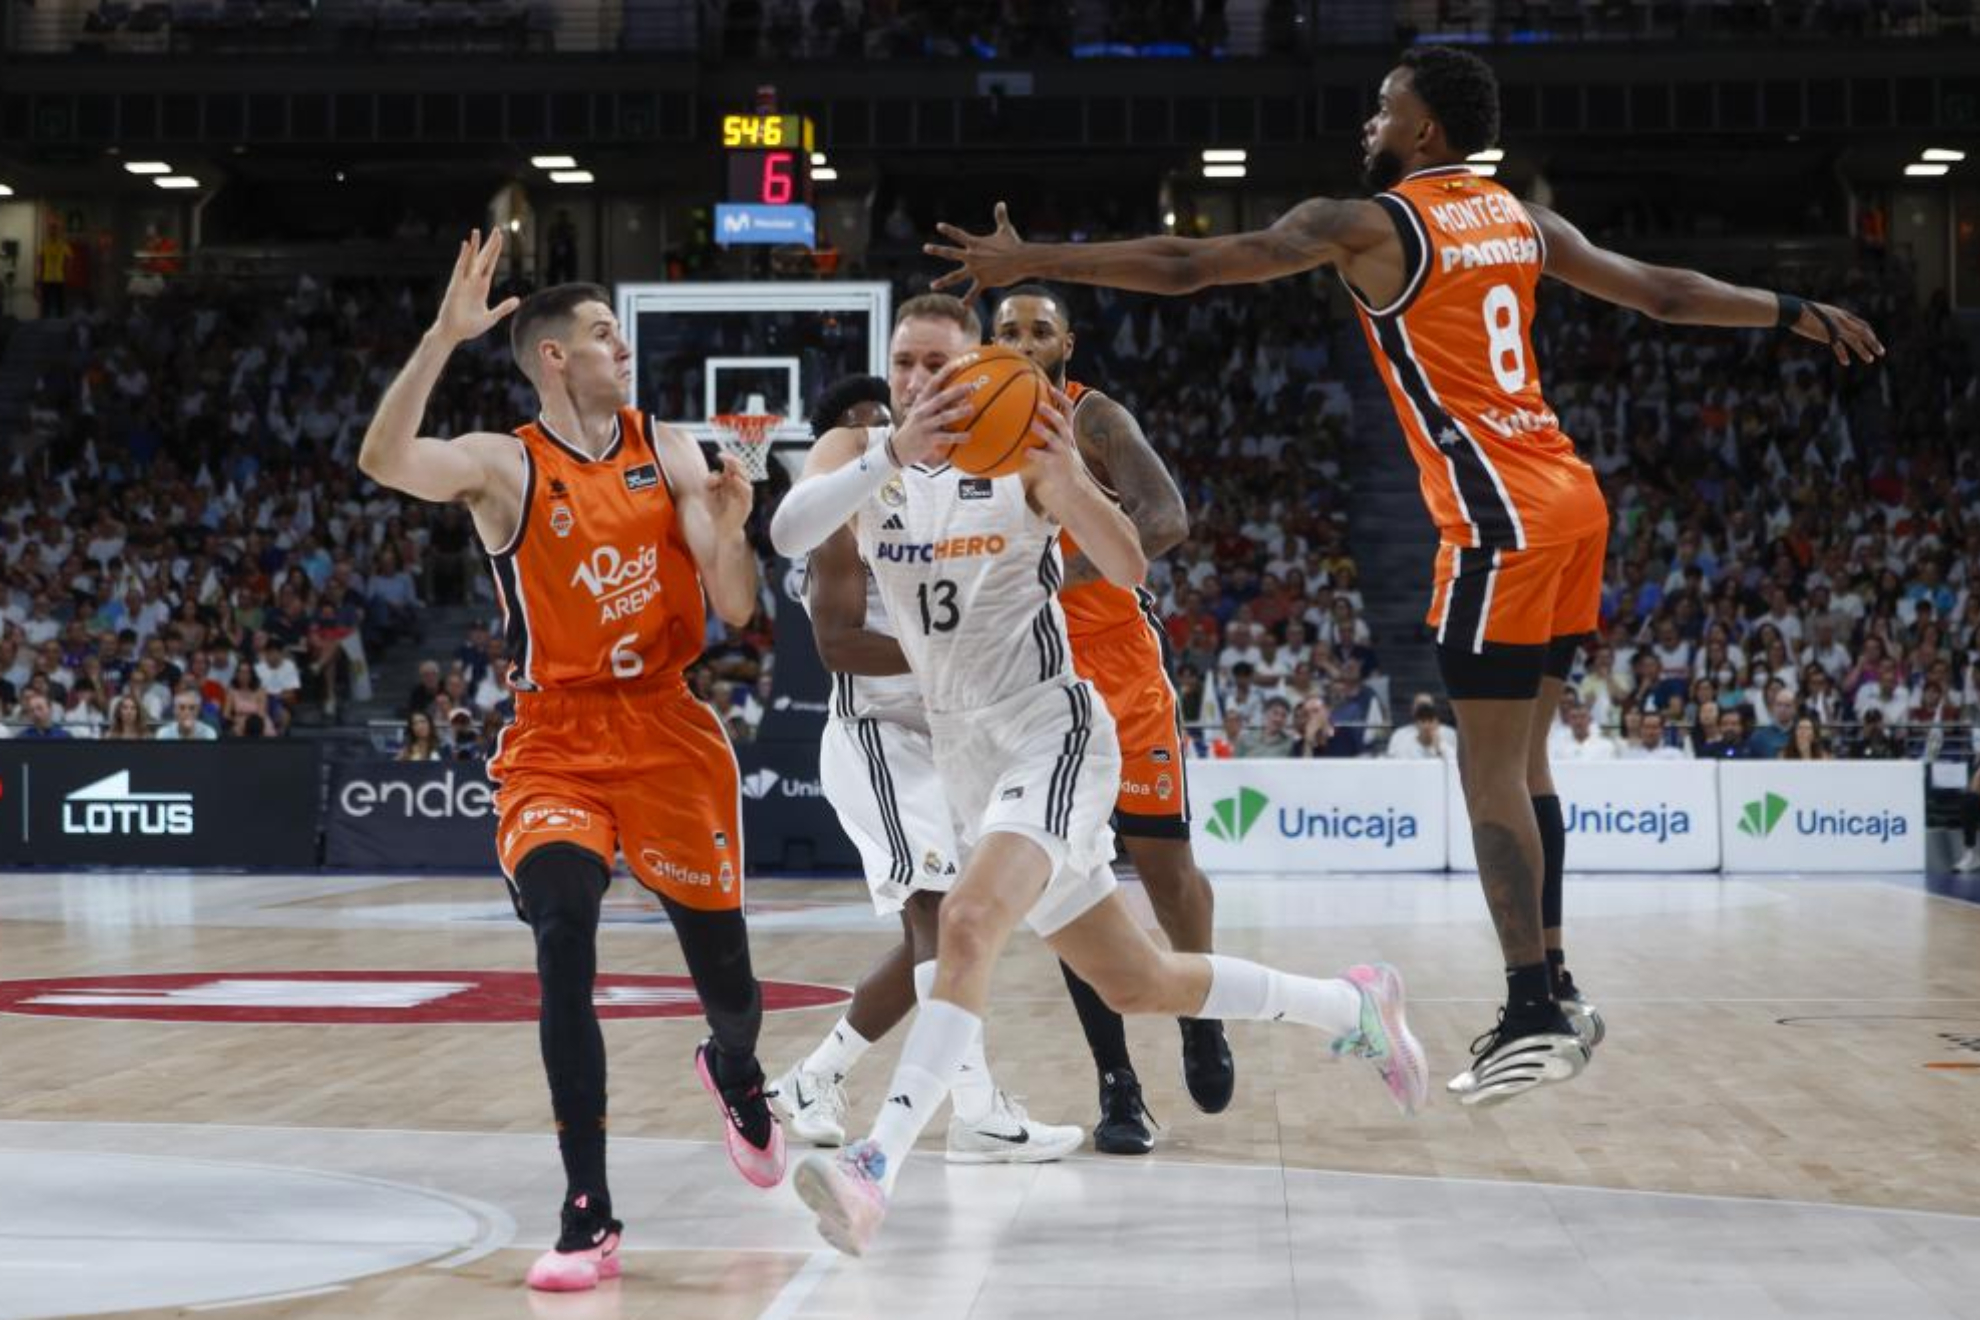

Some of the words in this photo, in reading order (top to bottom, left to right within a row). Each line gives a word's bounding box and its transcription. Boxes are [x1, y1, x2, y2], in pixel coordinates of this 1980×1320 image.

[763, 152, 793, 204] 6
[1482, 284, 1526, 394] 8
[917, 579, 960, 636] 13
[610, 633, 643, 678] 6
[340, 769, 492, 818] ende
[781, 779, 825, 797] Uni
[63, 803, 193, 834] LOTUS
[1278, 806, 1417, 848] Unicaja
[1796, 809, 1908, 844] Unicaja
